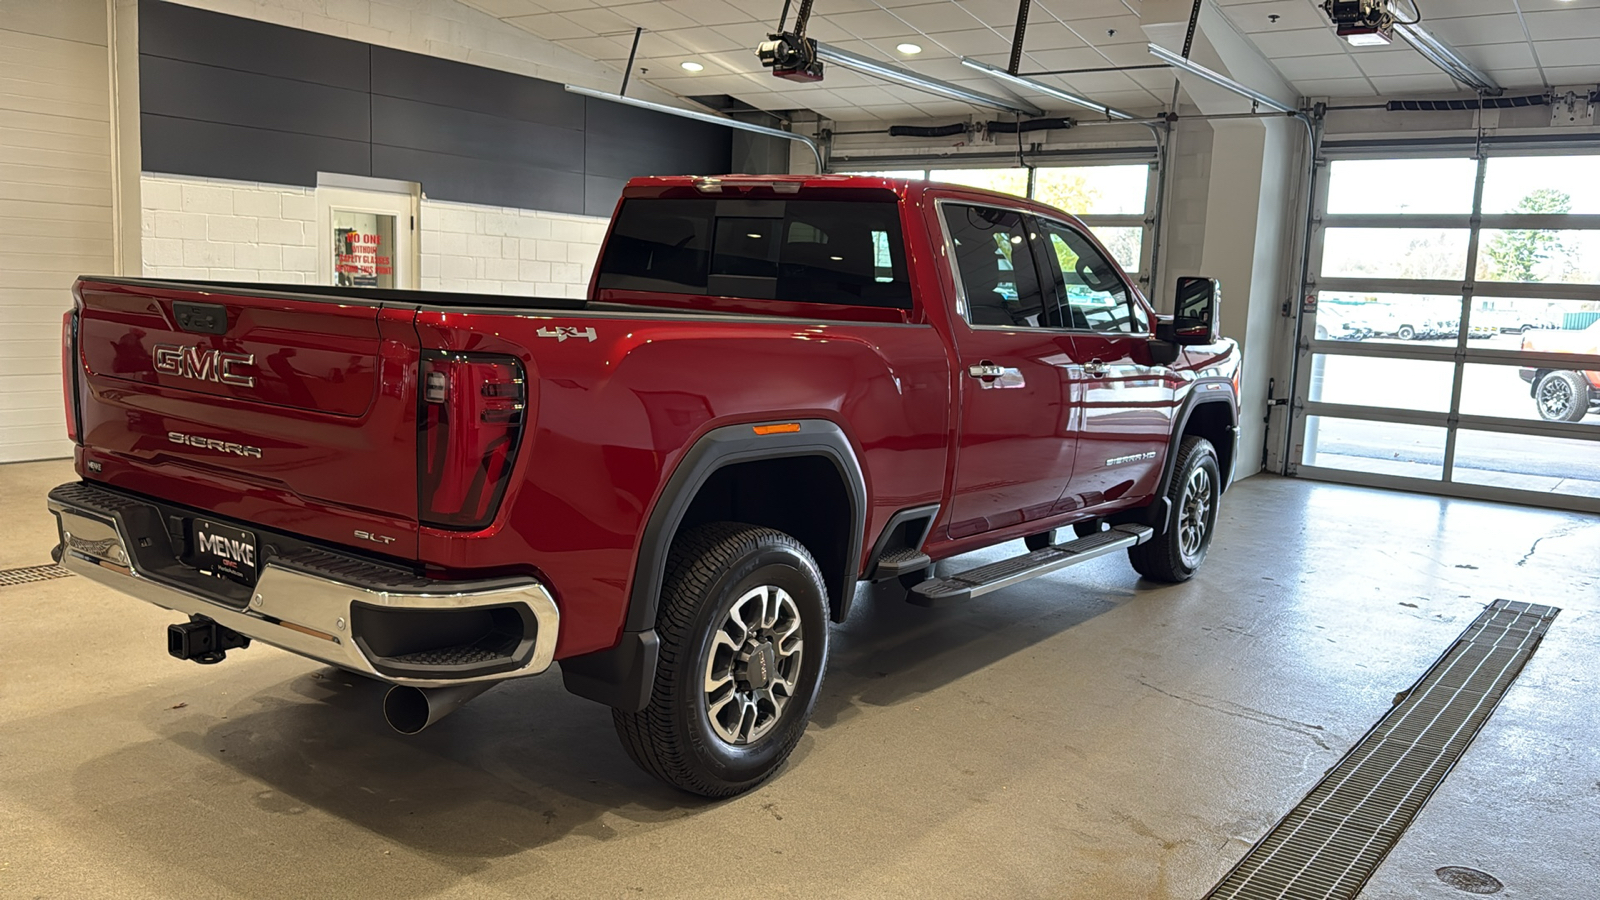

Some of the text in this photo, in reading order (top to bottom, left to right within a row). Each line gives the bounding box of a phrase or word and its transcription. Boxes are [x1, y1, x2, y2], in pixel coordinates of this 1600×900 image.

[347, 233, 381, 244] NO ONE
[339, 254, 389, 265] SAFETY GLASSES
[360, 266, 373, 274] THIS
[153, 344, 254, 388] GMC
[168, 432, 262, 458] SIERRA
[1106, 451, 1156, 466] SIERRA HD
[354, 529, 396, 544] SLT
[198, 531, 254, 568] MENKE
